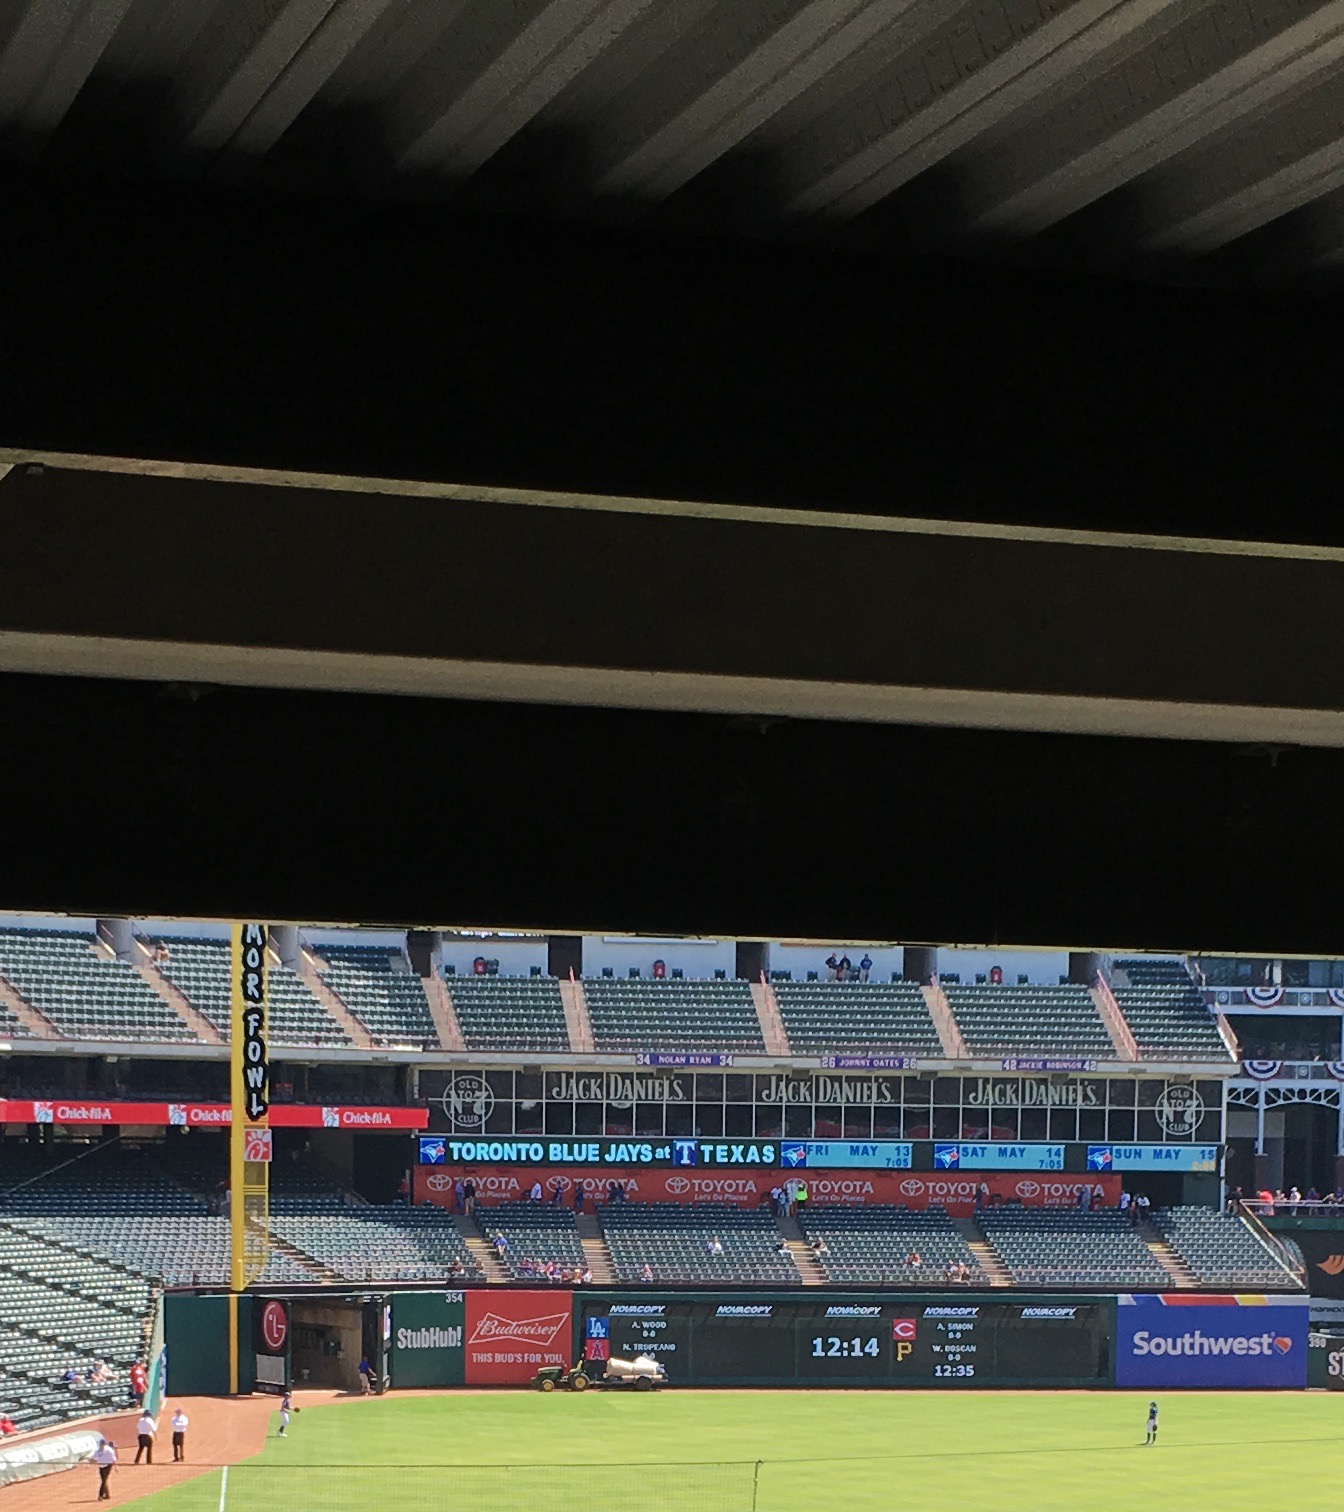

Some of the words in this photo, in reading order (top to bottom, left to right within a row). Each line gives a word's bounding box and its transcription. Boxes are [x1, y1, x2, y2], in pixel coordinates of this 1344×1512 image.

[246, 1013, 264, 1115] FOWL
[637, 1054, 650, 1064] 34
[659, 1056, 686, 1064] NOLAN
[690, 1056, 711, 1064] RYAN
[720, 1055, 732, 1066] 34
[821, 1057, 835, 1068] 26
[903, 1058, 917, 1069] 26
[1003, 1060, 1016, 1070] 42
[1083, 1061, 1096, 1071] 42
[459, 1080, 478, 1088] OLD
[552, 1074, 603, 1099] JACK
[762, 1076, 812, 1102] JACK
[969, 1078, 1018, 1105] JACK
[1170, 1090, 1190, 1098] OLD
[57, 1106, 112, 1121] Chick-fil-A
[343, 1111, 392, 1125] Chick-fil-A
[458, 1115, 479, 1123] CLUB
[449, 1142, 544, 1161] TORONTO
[549, 1143, 599, 1161] BLUE
[604, 1144, 653, 1162] JAYS
[655, 1147, 671, 1160] at
[700, 1145, 775, 1163] TEXAS
[807, 1145, 829, 1155] FRI
[850, 1145, 878, 1156] MAY
[895, 1146, 910, 1156] 13
[962, 1147, 987, 1157] SAT
[998, 1147, 1026, 1158] MAY
[1047, 1148, 1061, 1158] 14
[1115, 1149, 1142, 1159] SUN
[1153, 1149, 1181, 1159] MAY
[1200, 1149, 1215, 1160] 15
[886, 1158, 909, 1167] 7:05
[1039, 1160, 1062, 1169] 7:05
[692, 1180, 756, 1192] TOYOTA
[810, 1180, 874, 1194] TOYOTA
[926, 1182, 990, 1196] TOYOTA
[446, 1294, 463, 1303] 354
[610, 1305, 666, 1313] NOVACOPY
[716, 1305, 772, 1314] NOVACOPY
[826, 1306, 882, 1315] NOVACOPY
[924, 1307, 979, 1315] NOVACOPY
[1022, 1307, 1077, 1316] NOVACOPY
[480, 1313, 557, 1337] Budweiser
[397, 1326, 463, 1350] StubHub!
[1133, 1330, 1273, 1356] Southwest
[1309, 1337, 1326, 1348] 390
[812, 1337, 879, 1357] 12:14
[472, 1352, 493, 1364] THIS
[495, 1352, 522, 1364] BUD'S
[524, 1353, 542, 1364] FOR
[935, 1365, 975, 1376] 12:35
